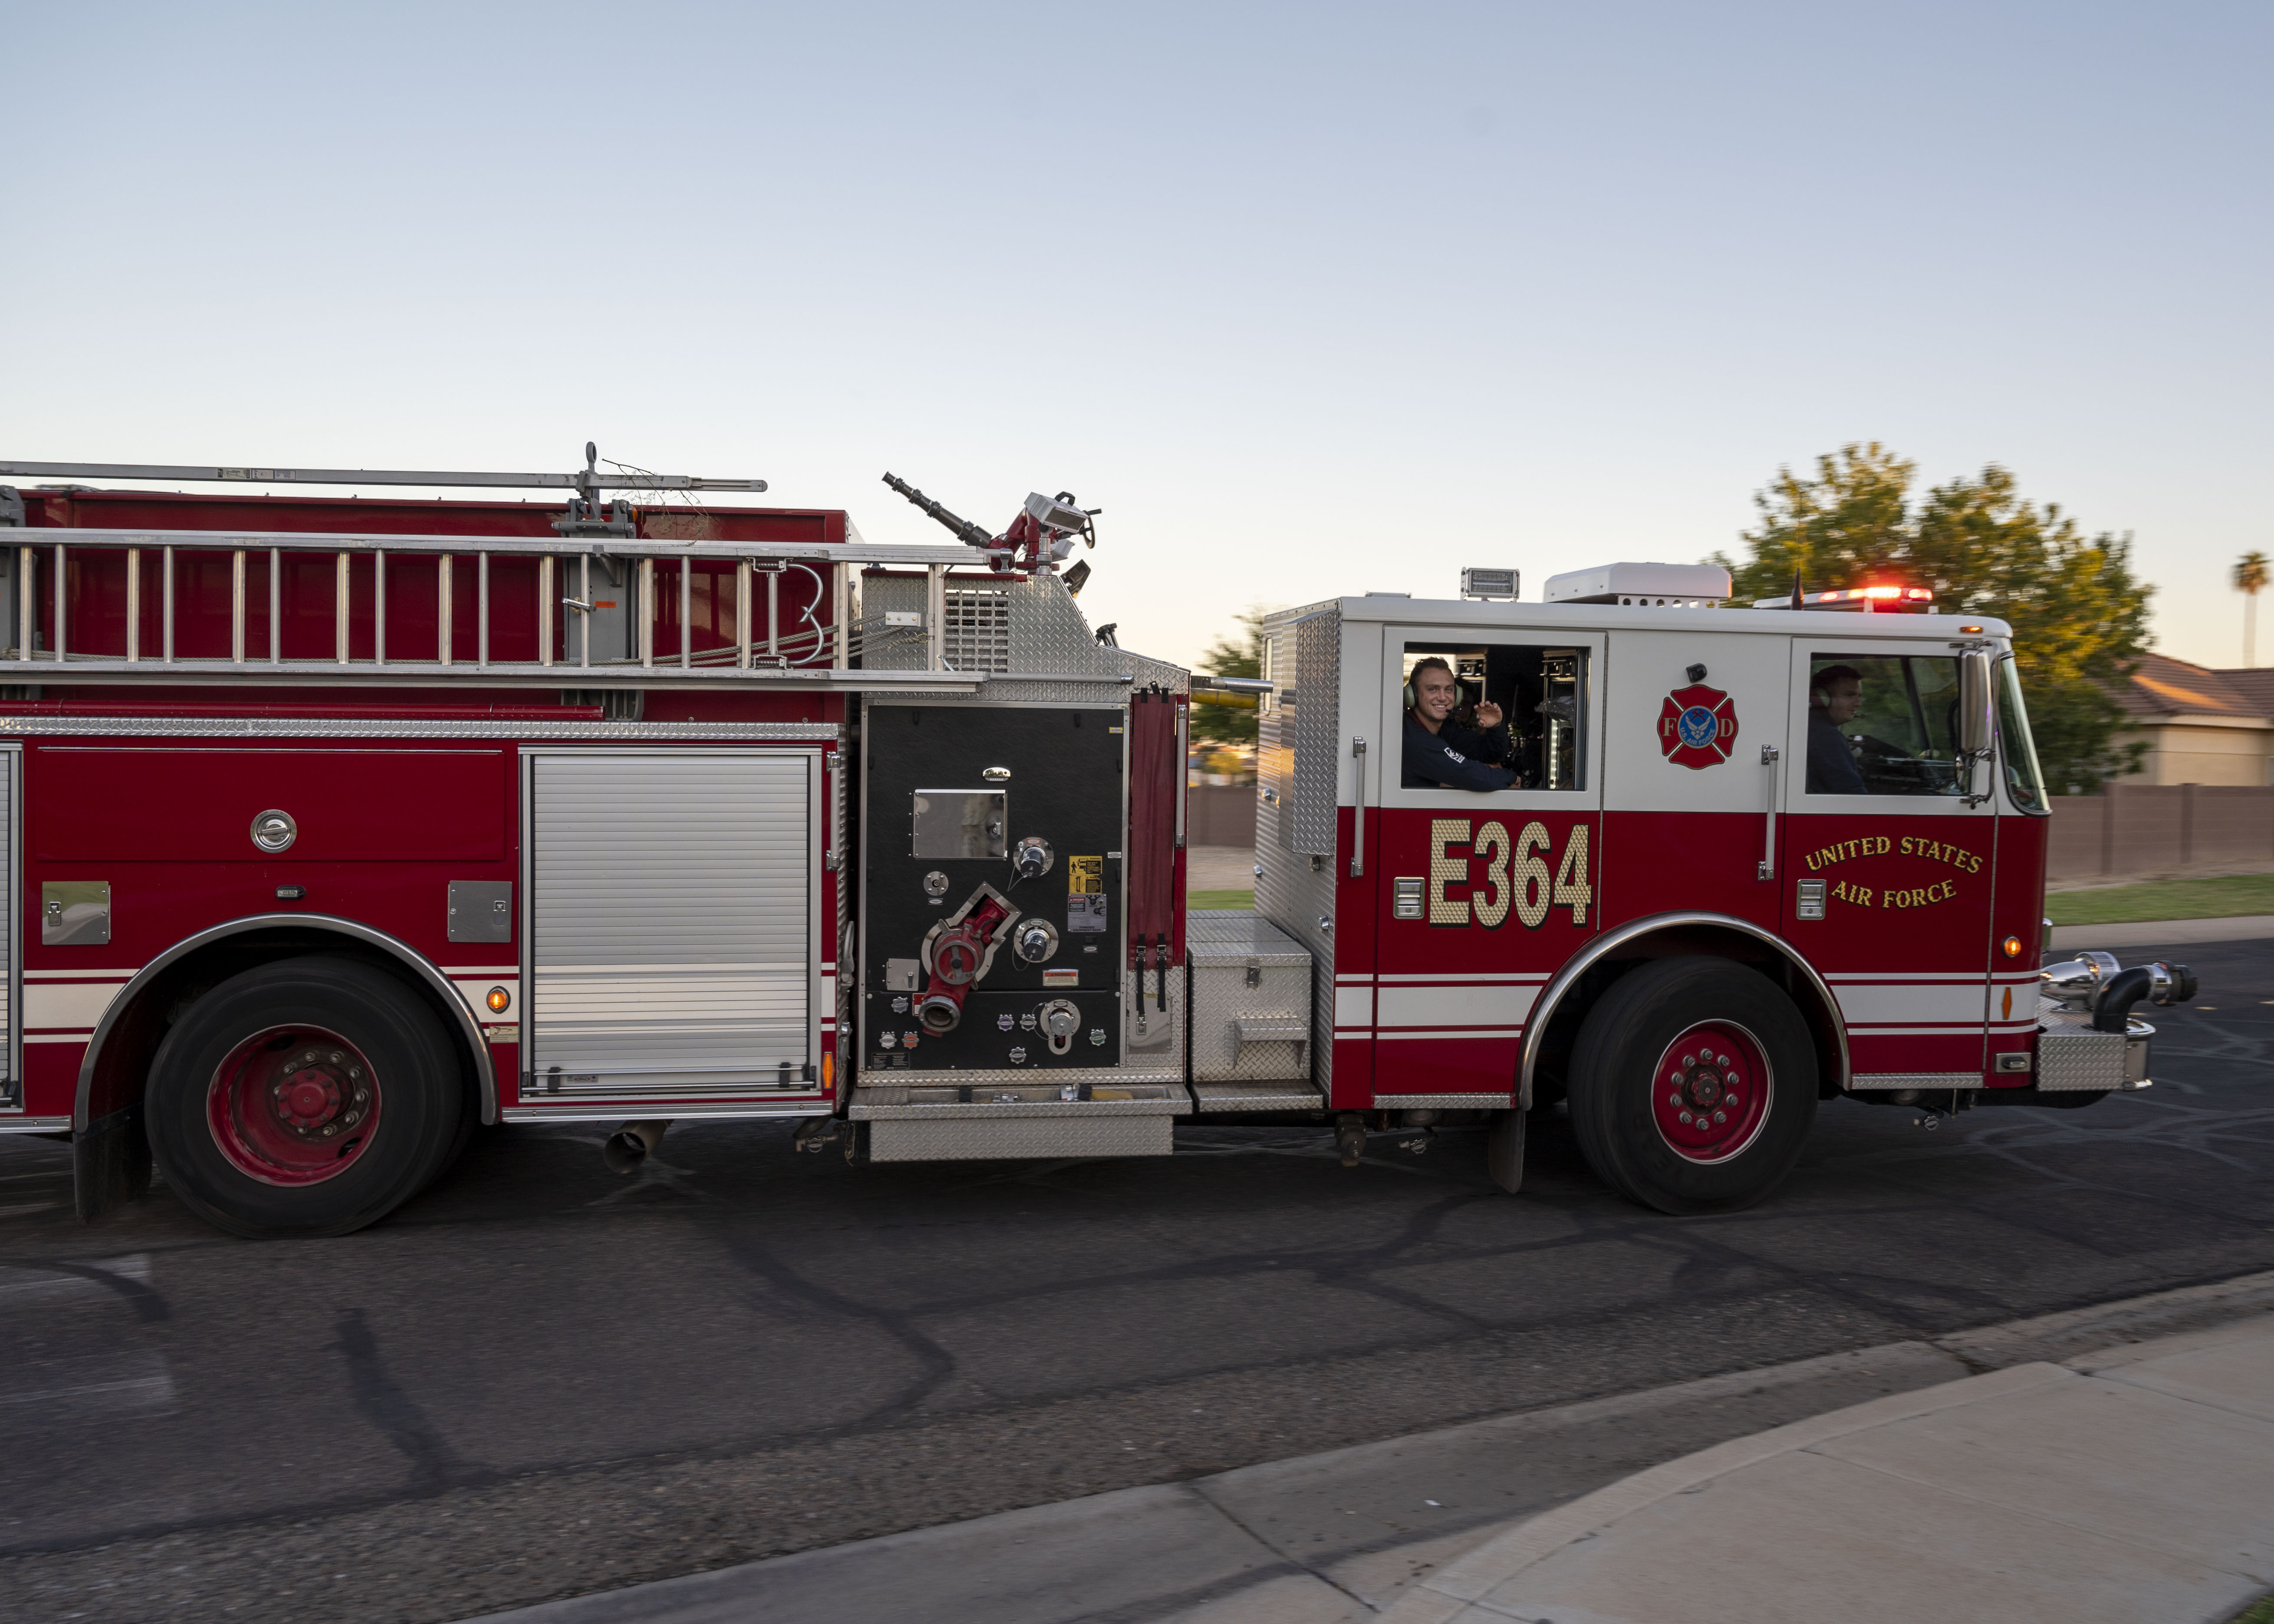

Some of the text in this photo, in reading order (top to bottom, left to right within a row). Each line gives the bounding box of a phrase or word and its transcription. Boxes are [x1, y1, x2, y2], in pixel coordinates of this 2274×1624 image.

[1662, 717, 1734, 737] F D
[1698, 729, 1715, 745] FORCE
[1804, 836, 1983, 874] UNITED STATES
[1429, 818, 1593, 931] E364
[1830, 879, 1957, 909] AIR FORCE
